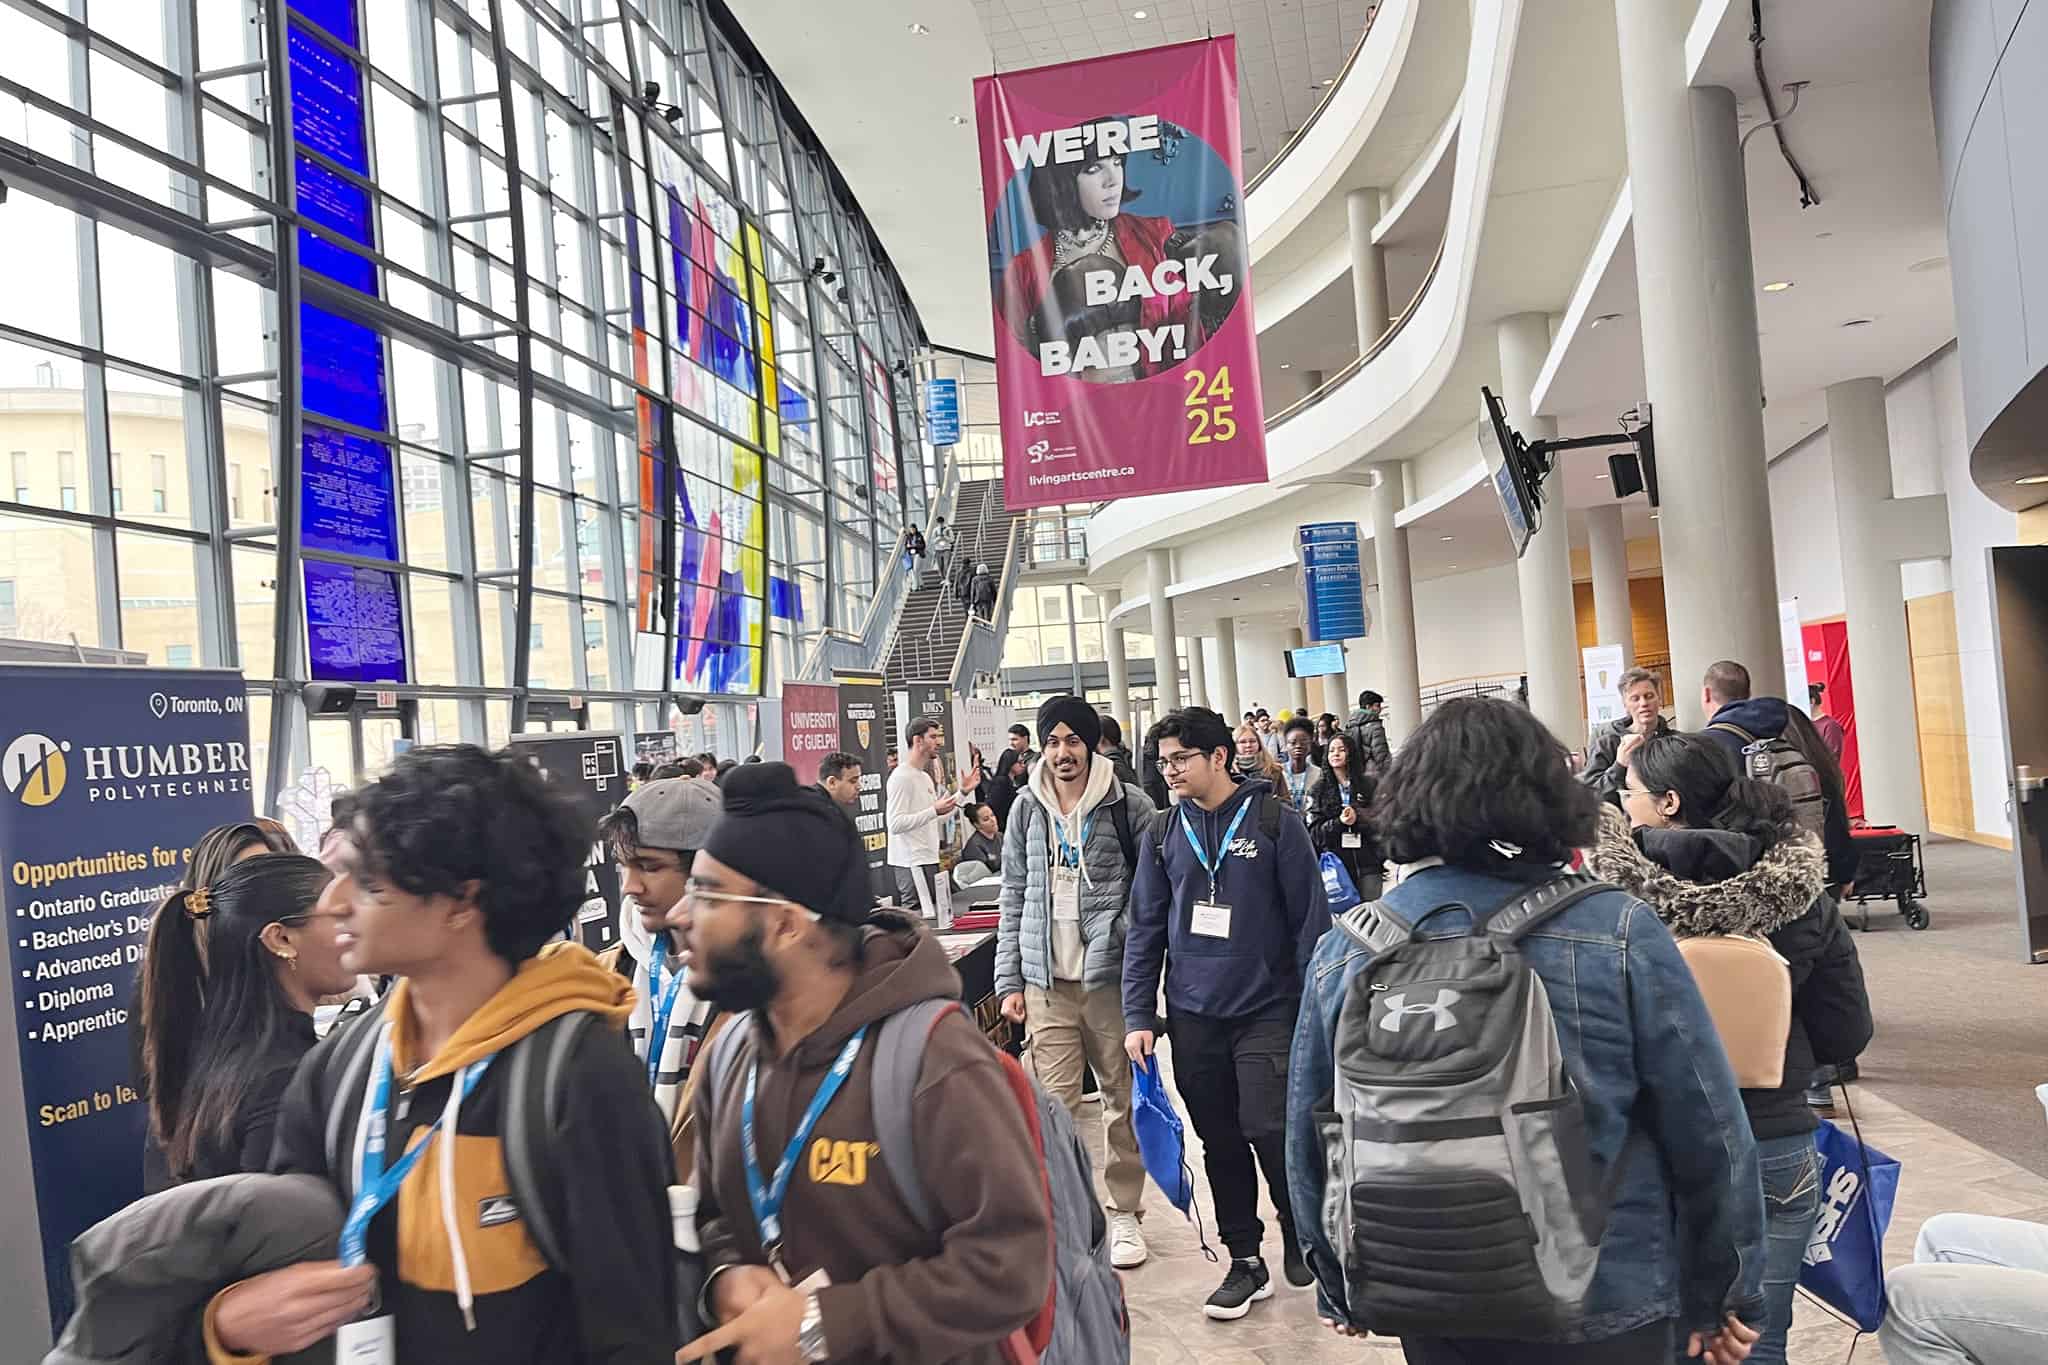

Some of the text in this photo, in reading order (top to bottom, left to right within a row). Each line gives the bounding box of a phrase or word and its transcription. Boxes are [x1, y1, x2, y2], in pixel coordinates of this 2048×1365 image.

[1003, 115, 1161, 170] WE'RE
[1084, 254, 1233, 306] BACK,
[1039, 324, 1187, 377] BABY!
[1184, 366, 1233, 406] 24
[1187, 405, 1236, 445] 25
[1029, 466, 1135, 487] livingartscentre.ca
[170, 695, 244, 714] Toronto, ON
[790, 711, 837, 729] UNIVERSITY
[792, 733, 837, 751] OF GUELPH
[83, 741, 249, 780] HUMBER
[89, 777, 252, 802] POLYTECHNIC
[13, 846, 194, 888] Opportunities for e
[29, 895, 97, 920] Ontario
[32, 919, 123, 950] Bachelor's
[36, 947, 121, 981] Advanced
[39, 983, 114, 1011] Diploma
[40, 1100, 89, 1126] Scan
[94, 1092, 112, 1111] to
[809, 1137, 868, 1186] CAT
